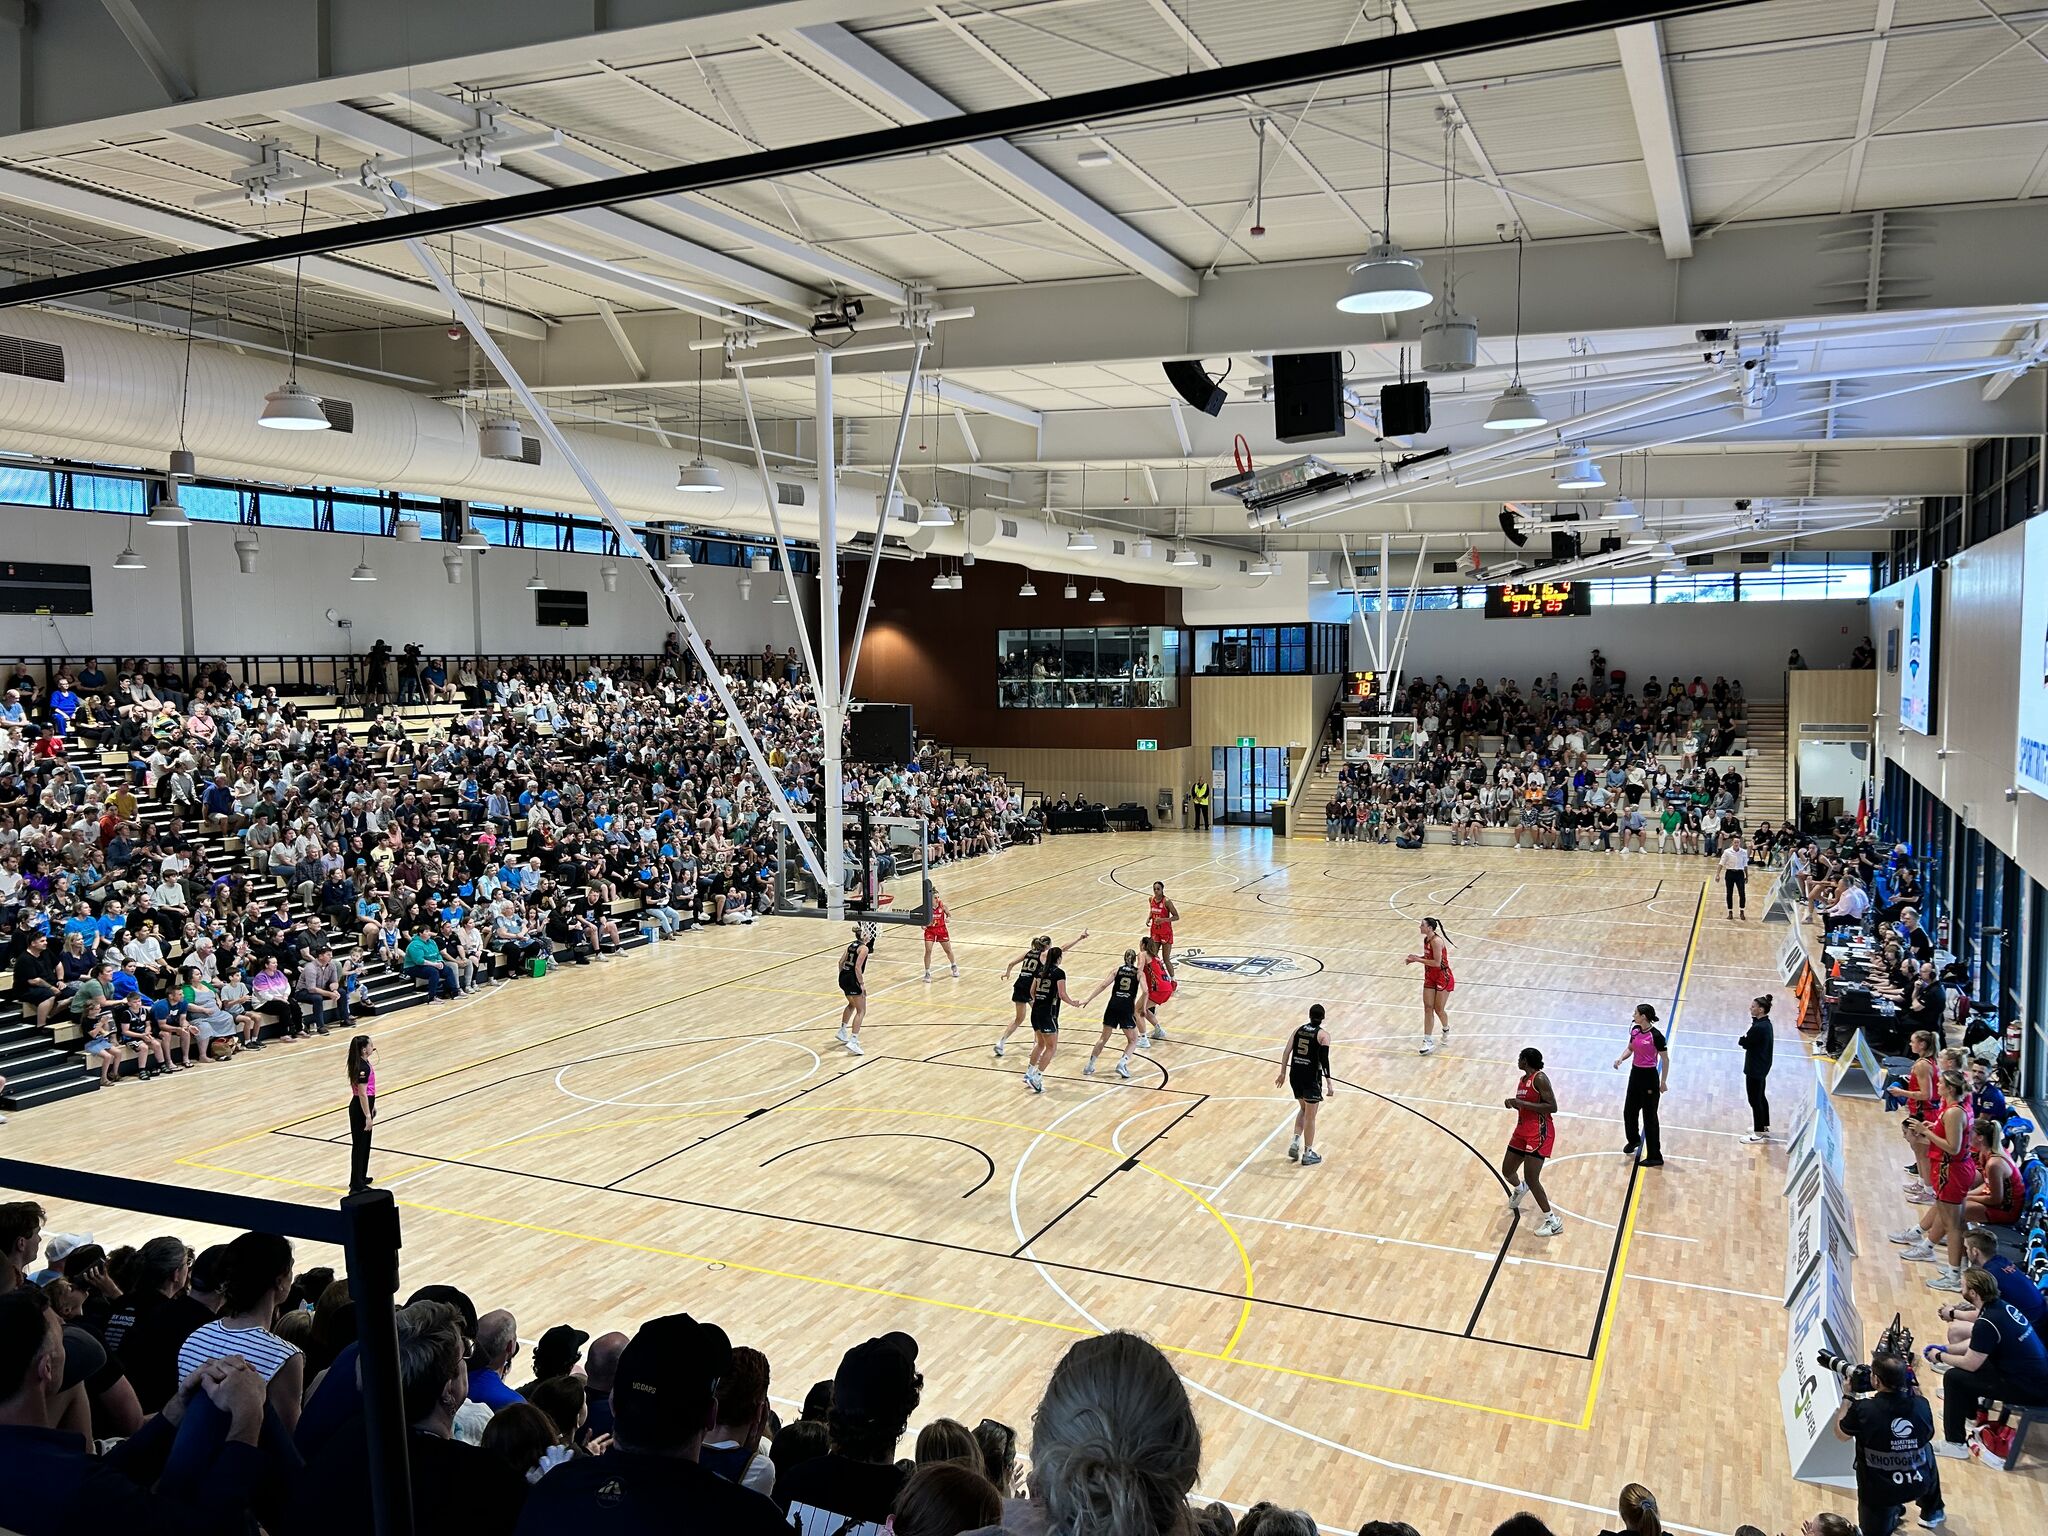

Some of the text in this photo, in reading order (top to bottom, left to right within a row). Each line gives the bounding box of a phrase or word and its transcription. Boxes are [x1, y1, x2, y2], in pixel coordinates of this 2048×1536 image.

[1512, 599, 1562, 613] 31 2 25
[1022, 958, 1039, 972] 10
[1036, 977, 1051, 993] 12
[1120, 977, 1131, 991] 9
[1297, 1038, 1310, 1056] 5
[1796, 1352, 1806, 1385] GERALD
[1804, 1400, 1816, 1440] SLAVEN
[1892, 1470, 1924, 1485] 014
